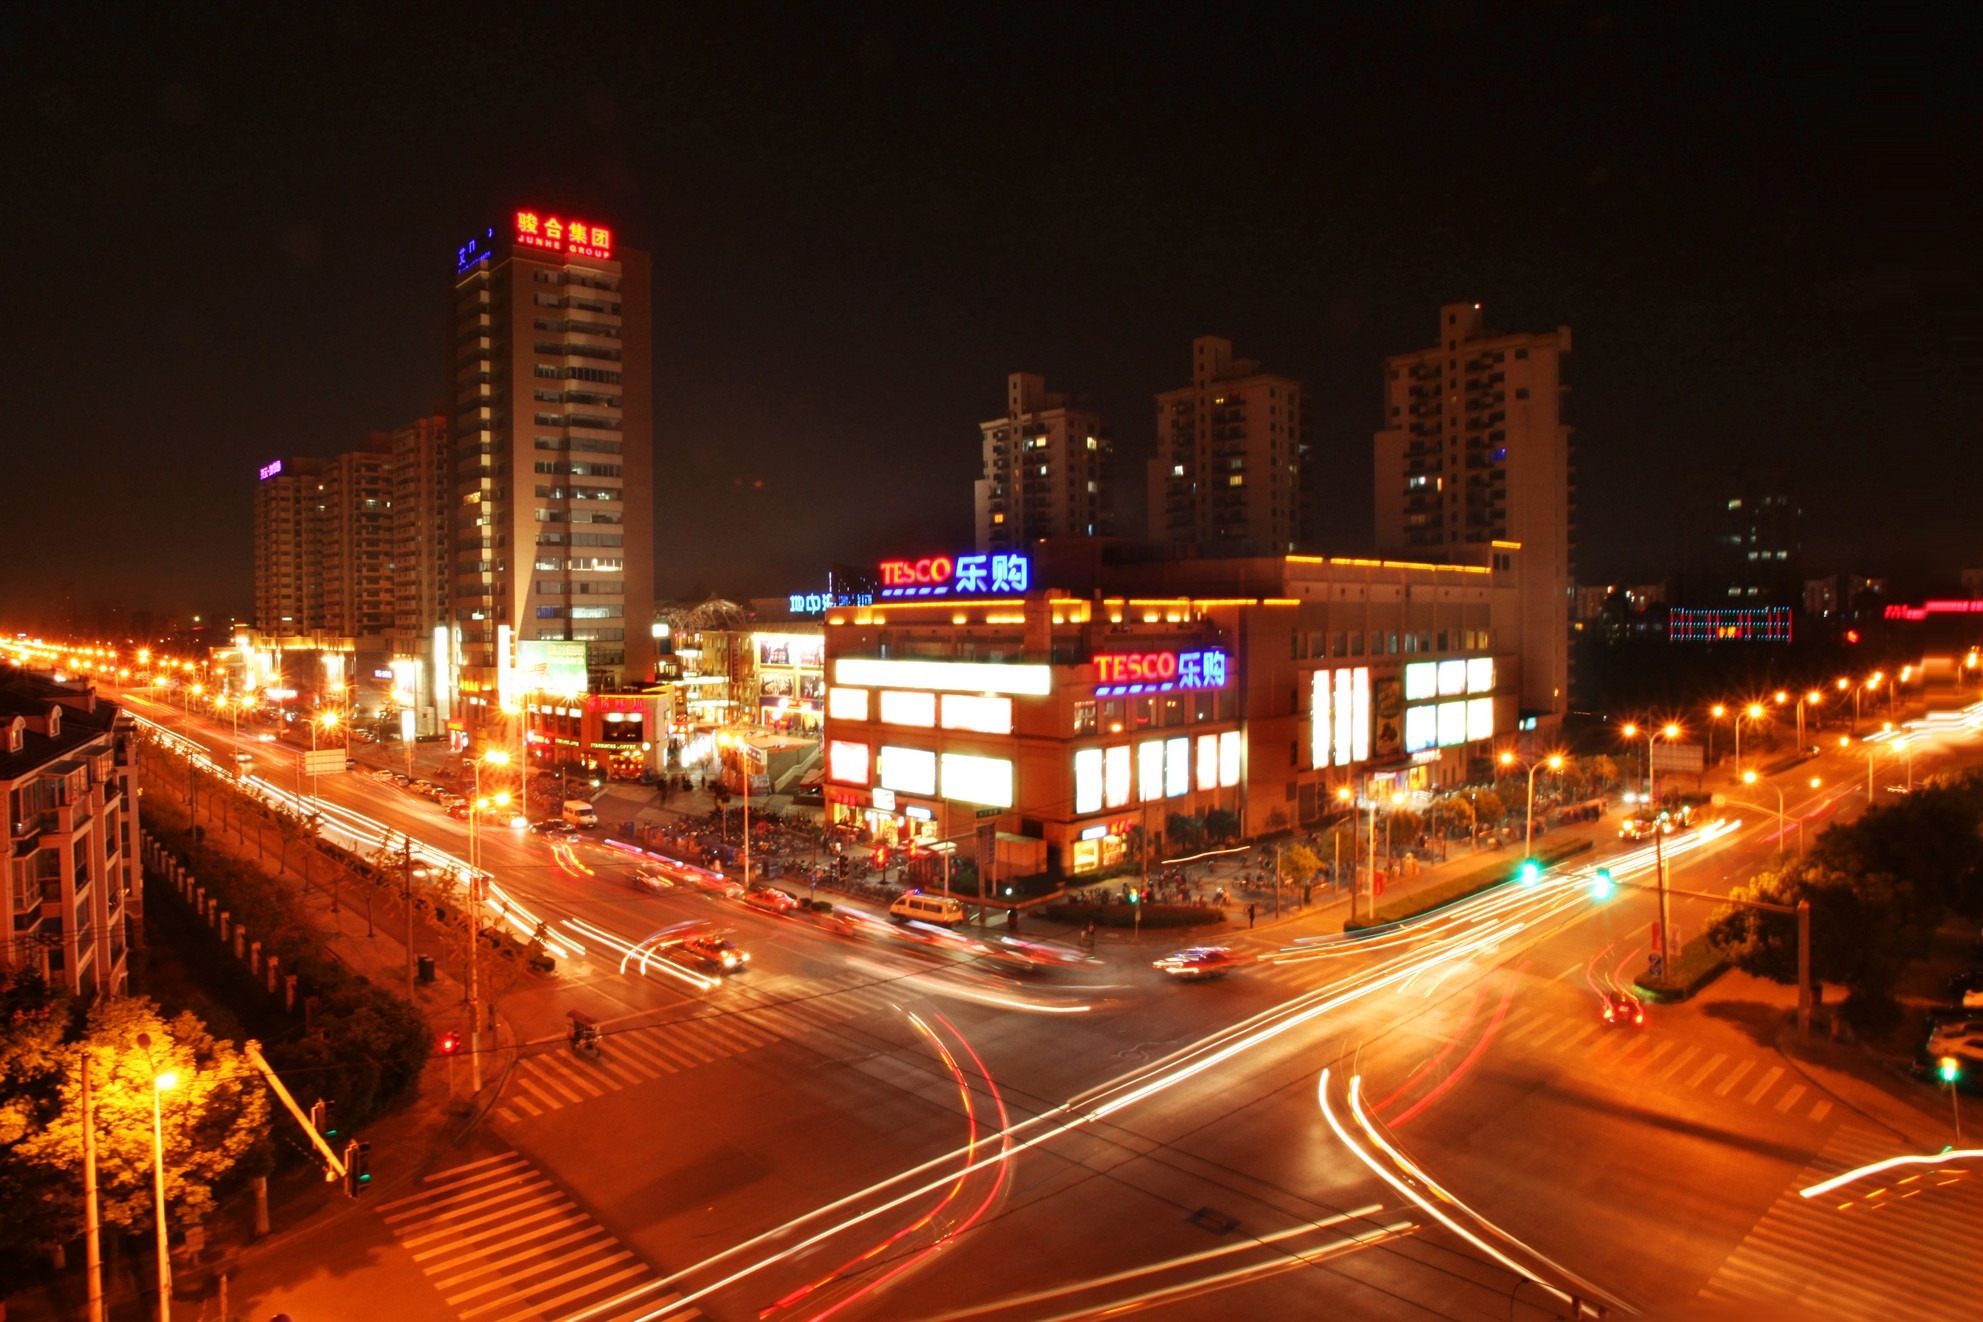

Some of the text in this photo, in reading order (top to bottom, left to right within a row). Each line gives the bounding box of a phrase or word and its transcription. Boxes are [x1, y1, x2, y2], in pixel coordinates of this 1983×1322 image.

[517, 211, 610, 249] 骏合集团
[518, 234, 610, 259] JUNHE GROUP
[879, 553, 1029, 593] TESCO 乐购
[1093, 650, 1226, 689] TESCO 乐购
